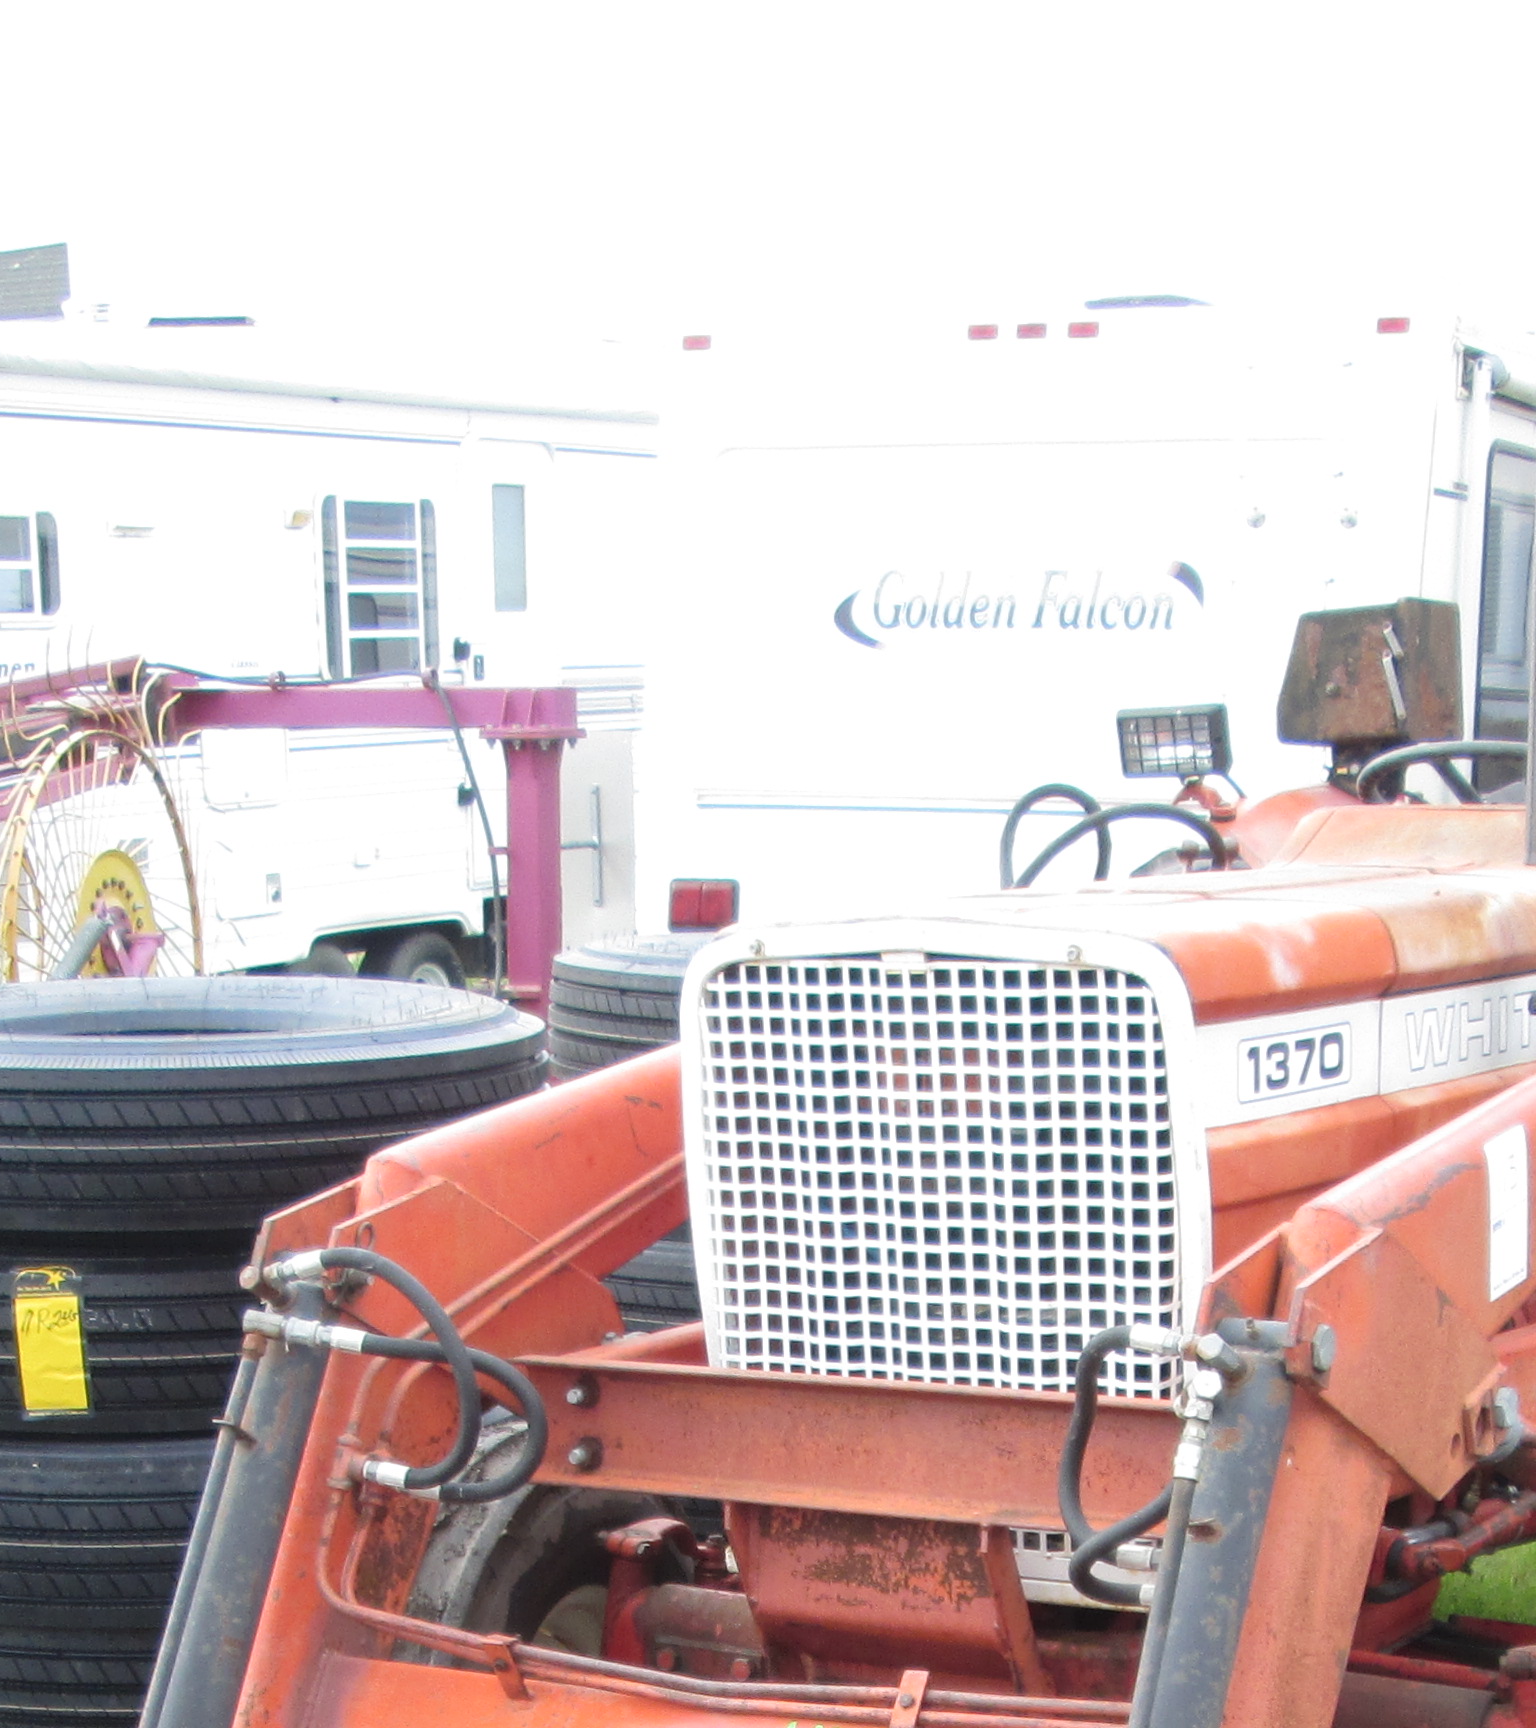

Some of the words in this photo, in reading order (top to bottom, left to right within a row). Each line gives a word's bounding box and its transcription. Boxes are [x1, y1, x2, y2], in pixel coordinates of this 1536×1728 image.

[873, 569, 1015, 630] Golden
[1031, 569, 1174, 630] Falcon
[1247, 1031, 1345, 1094] 1370
